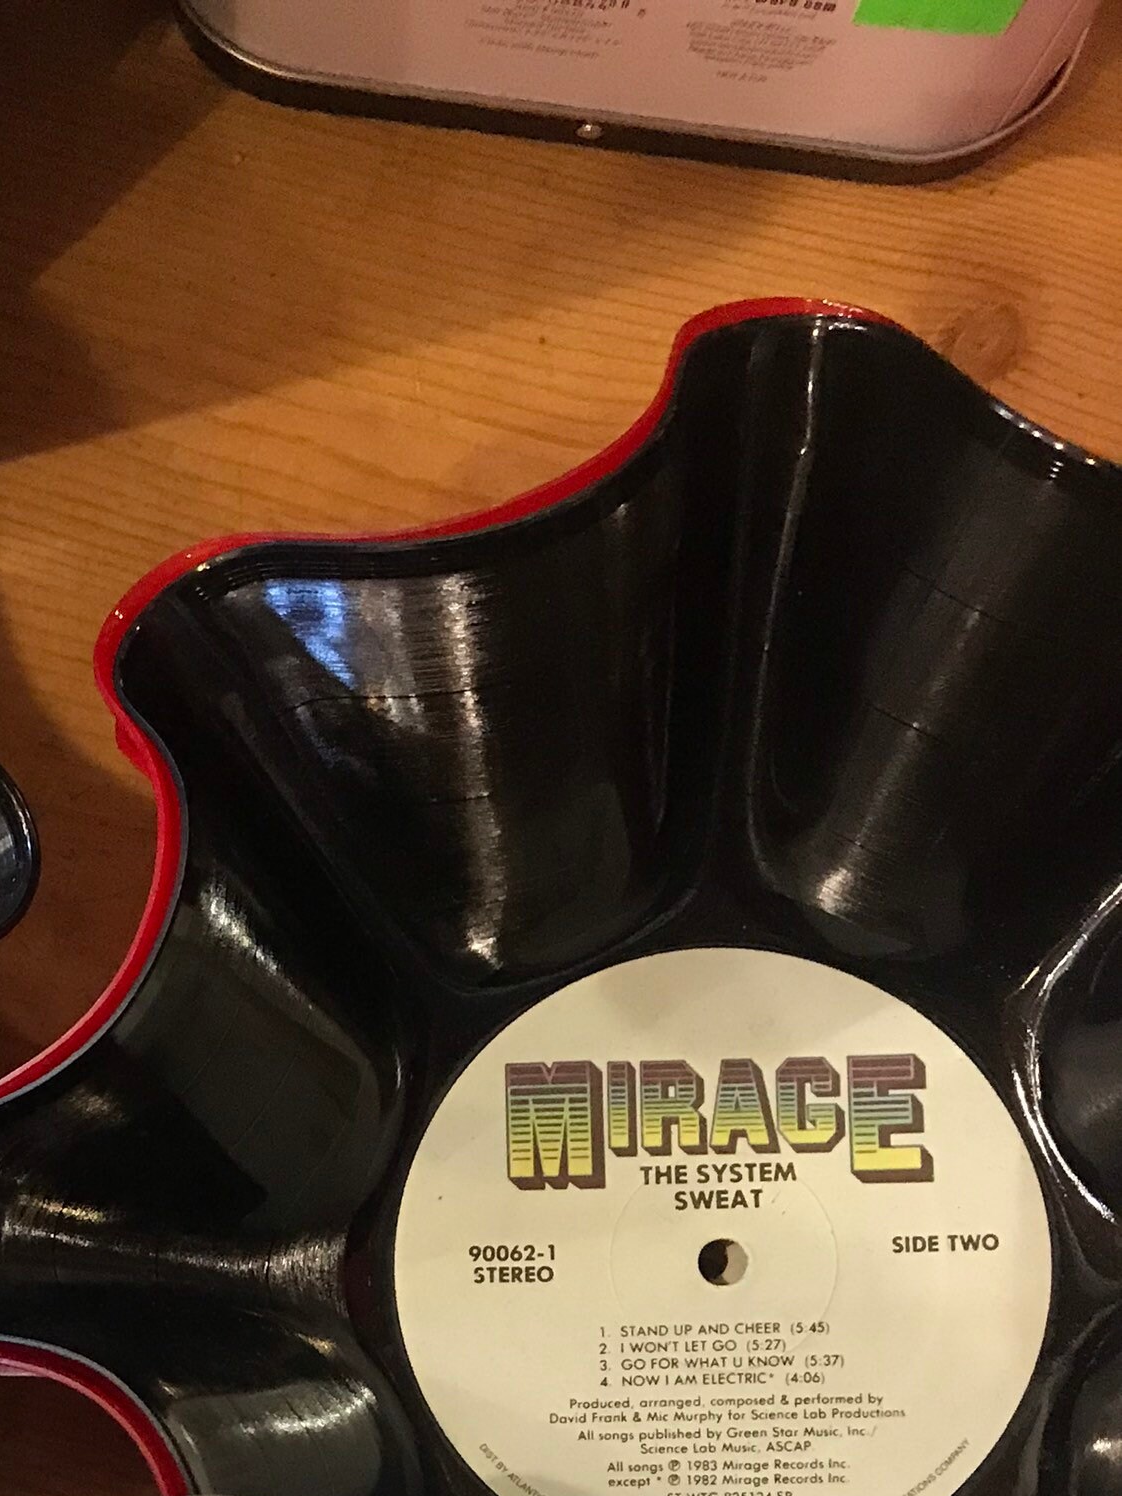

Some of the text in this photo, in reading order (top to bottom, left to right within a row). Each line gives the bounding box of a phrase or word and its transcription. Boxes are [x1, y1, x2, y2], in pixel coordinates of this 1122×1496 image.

[505, 1053, 934, 1191] MIRAGE
[640, 1161, 797, 1185] THE SYSTEM
[674, 1188, 763, 1211] SWEAT
[892, 1233, 1000, 1254] SIDE TWO
[468, 1244, 556, 1263] 90062-1
[473, 1265, 554, 1284] STEREO
[620, 1325, 669, 1338] STAND
[673, 1325, 693, 1336] UP
[697, 1323, 729, 1335] AND
[734, 1322, 781, 1334] CHEER
[629, 1341, 679, 1354] WON'T
[684, 1340, 708, 1352] LET
[712, 1339, 738, 1352] GO
[621, 1354, 845, 1371] GO FOR WHAT U KNOW (5:37)
[621, 1374, 660, 1387] NOW
[674, 1373, 698, 1385] AM
[785, 1371, 826, 1385] (4:06)
[569, 1392, 884, 1410] Produced, arranged, composed performed by
[549, 1407, 906, 1424] David Frank Mic Murphy for Science Lab Productions
[577, 1426, 843, 1443] All songs published by Green Star Music,
[640, 1442, 688, 1455] Science
[693, 1442, 717, 1454] Lab
[607, 1458, 851, 1475] All songs 1983 Mirage Records Inc.
[608, 1477, 651, 1489] except
[686, 1474, 717, 1486] 1982
[721, 1473, 769, 1487] Mirage
[774, 1472, 824, 1485] Records
